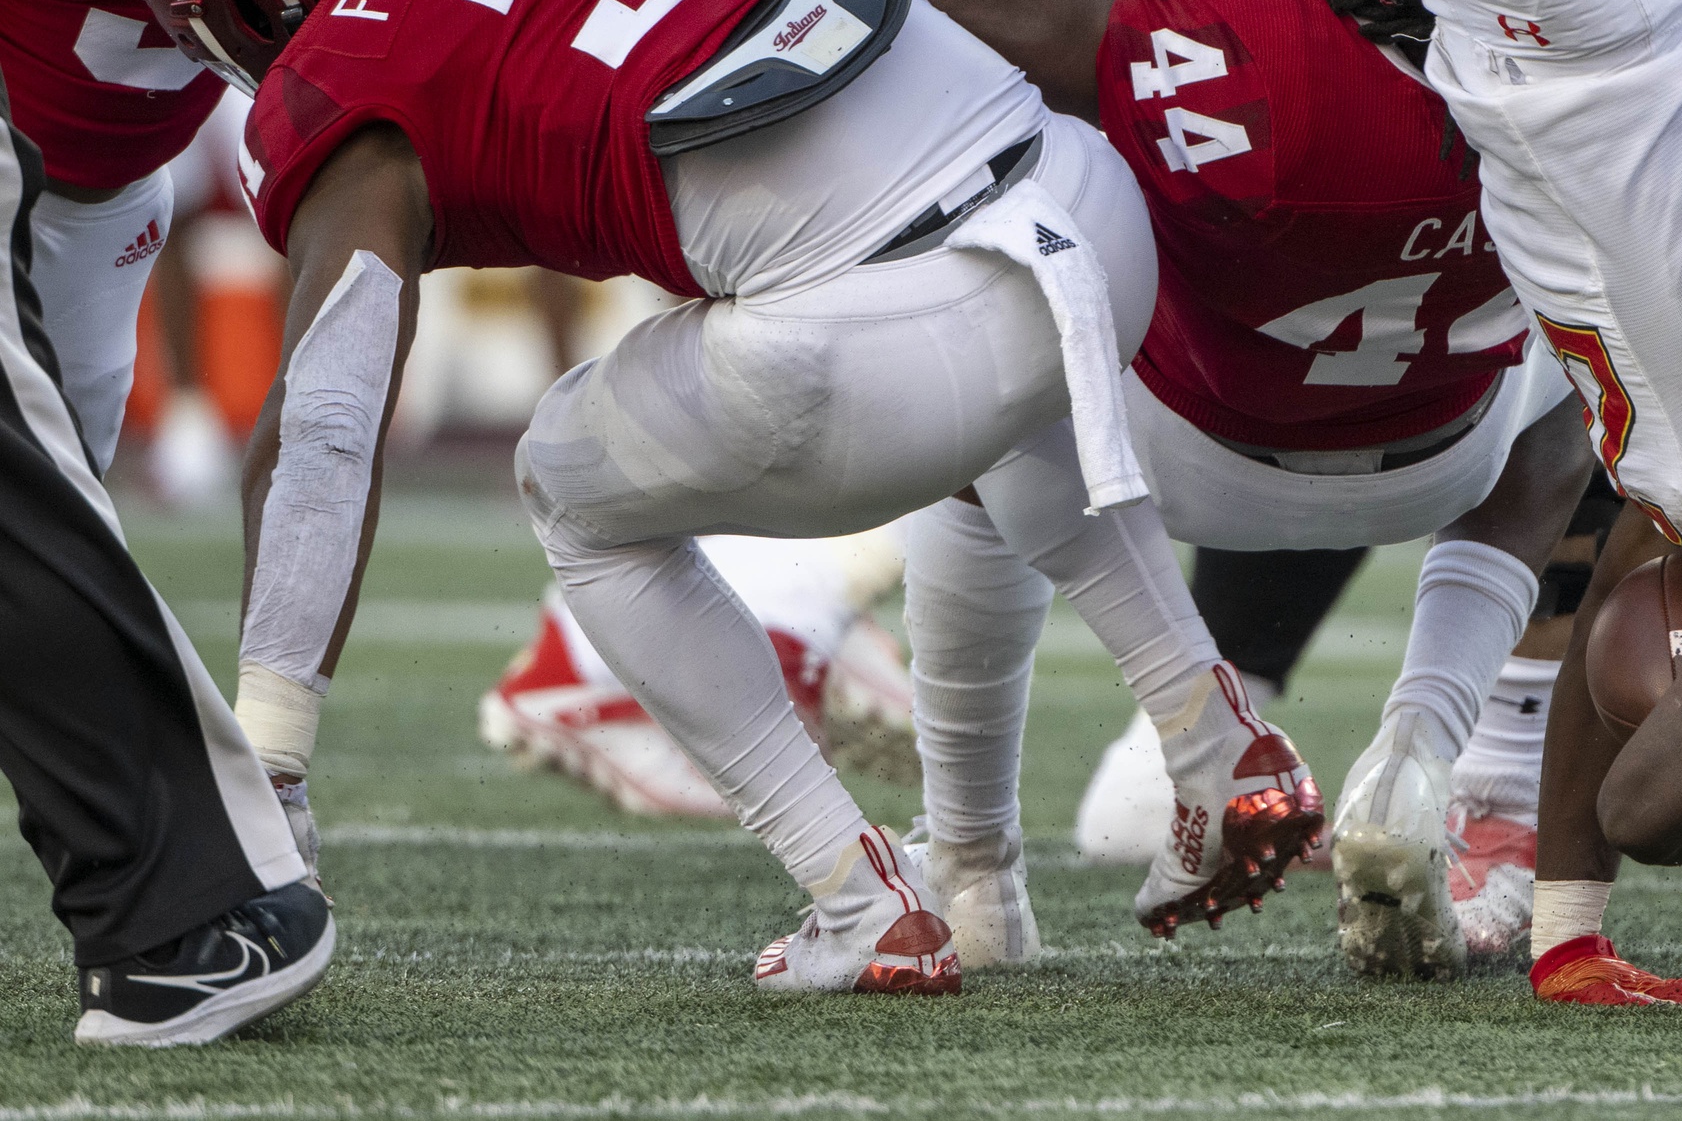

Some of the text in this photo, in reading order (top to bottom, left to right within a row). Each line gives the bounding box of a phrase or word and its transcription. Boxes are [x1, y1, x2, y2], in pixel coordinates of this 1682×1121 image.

[773, 4, 827, 52] Indiana
[1130, 28, 1252, 173] 44
[115, 239, 164, 267] adidas
[1039, 236, 1077, 256] adidas
[1182, 805, 1208, 875] adidas
